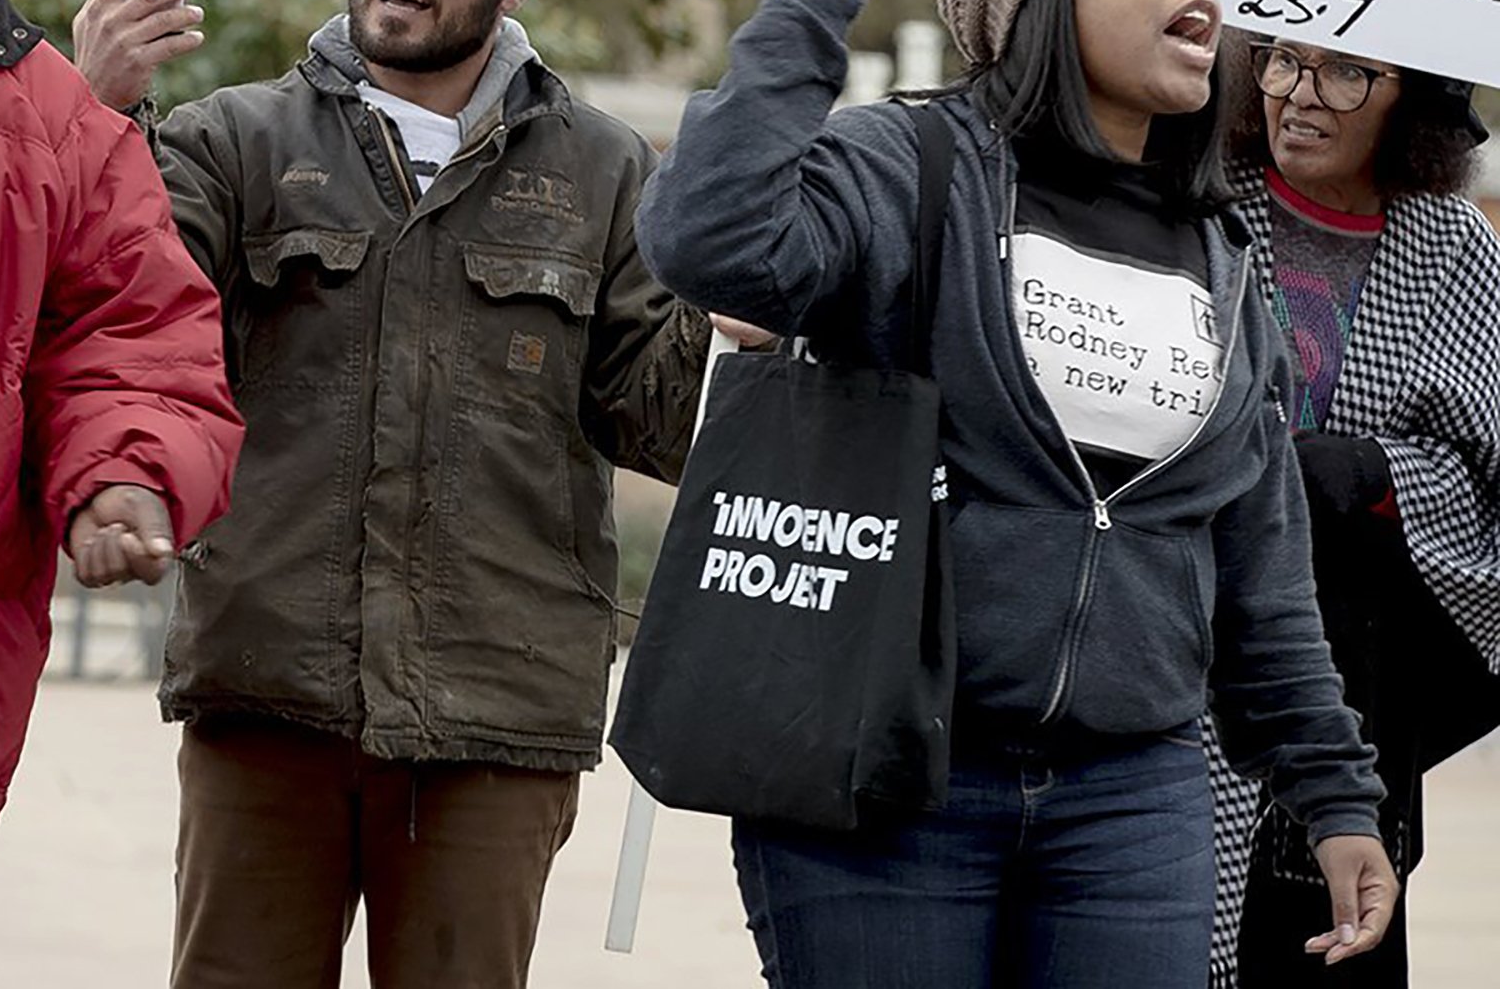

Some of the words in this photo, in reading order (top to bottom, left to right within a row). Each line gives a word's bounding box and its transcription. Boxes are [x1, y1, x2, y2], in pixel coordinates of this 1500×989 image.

[1022, 278, 1125, 328] Grant
[1024, 309, 1149, 371] Rodney
[1064, 364, 1128, 398] new
[1149, 380, 1206, 418] tri
